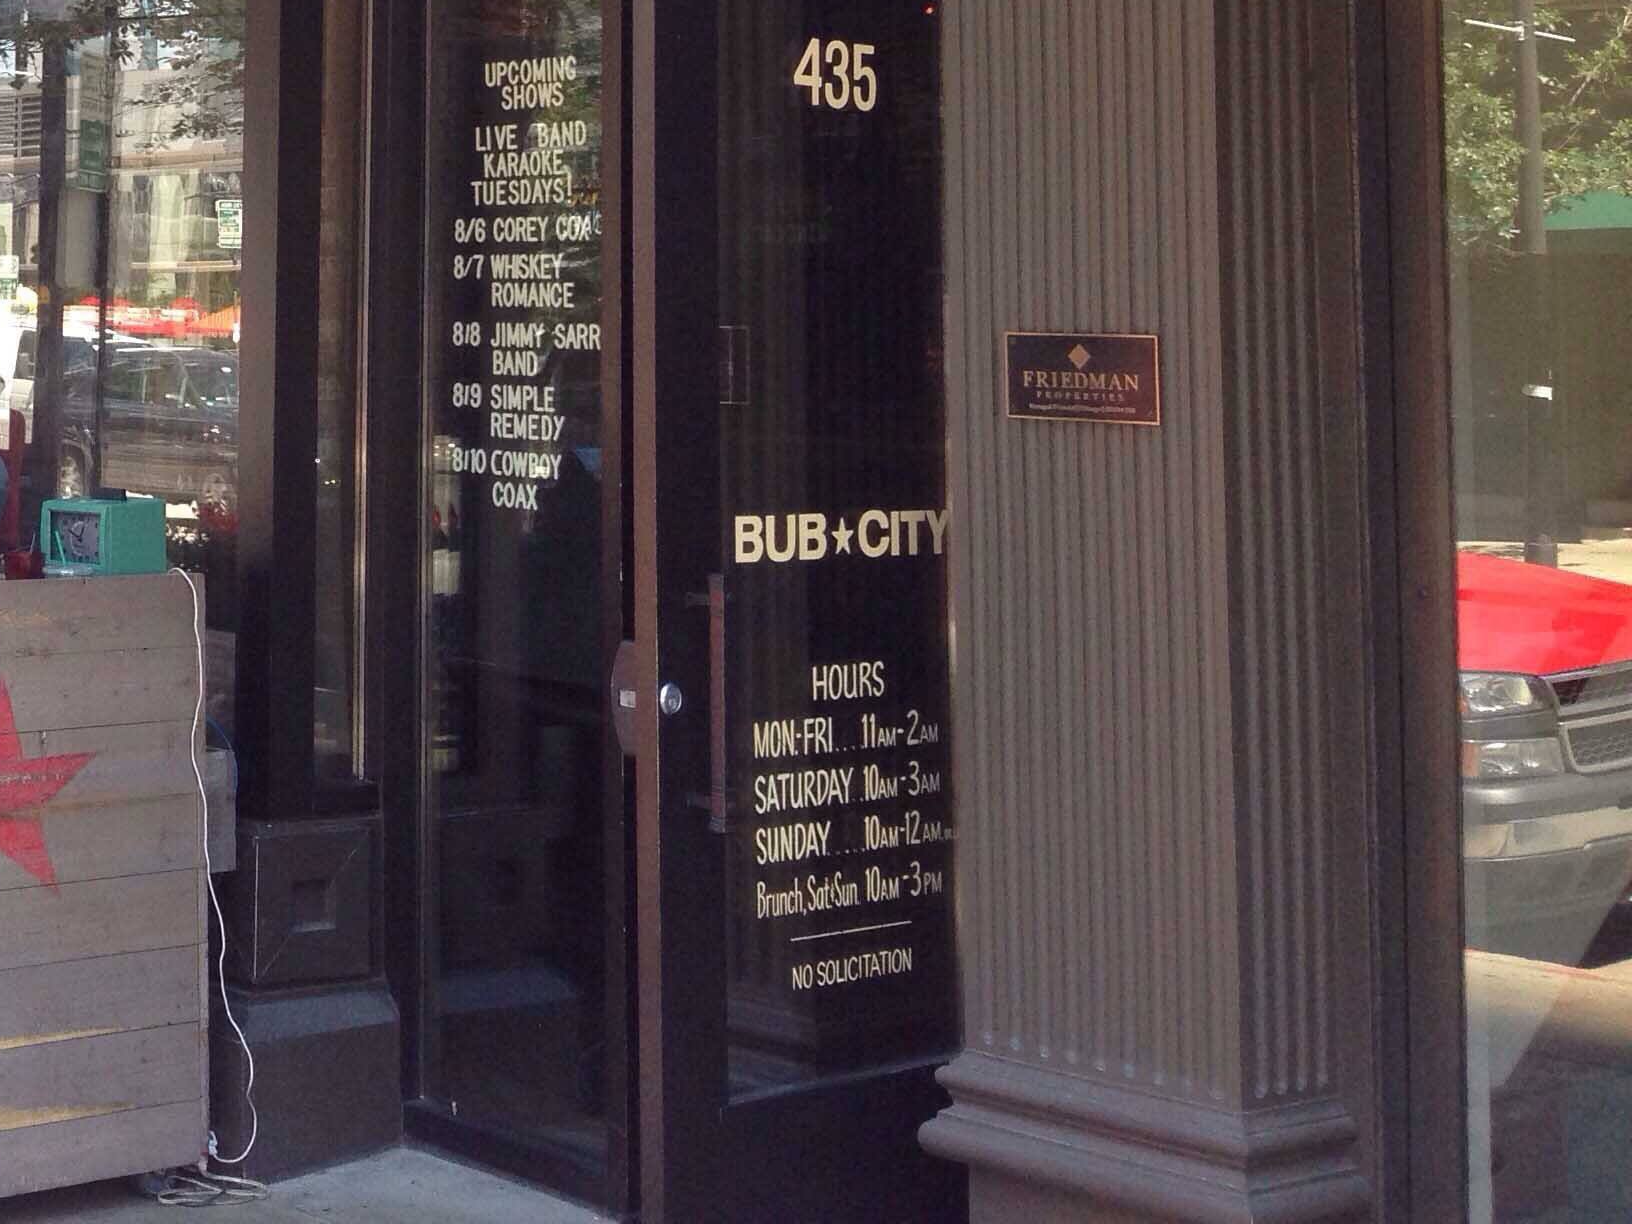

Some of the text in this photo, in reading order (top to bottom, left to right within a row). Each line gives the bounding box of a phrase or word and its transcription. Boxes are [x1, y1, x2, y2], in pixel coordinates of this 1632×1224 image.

[484, 55, 577, 87] UPCOMING
[793, 37, 877, 112] 435
[501, 82, 565, 110] SHOWS
[475, 120, 587, 151] LIVE BAND
[483, 149, 564, 178] KARAOKE
[470, 172, 573, 206] TUESDAYS!
[454, 218, 486, 243] 8/6
[493, 216, 549, 242] COREY
[453, 253, 564, 279] 8/7 WHISKEY
[491, 282, 575, 308] ROMANCE
[452, 321, 601, 350] 8/8 JIMMY SARR
[492, 350, 539, 376] BAND
[1023, 370, 1139, 391] FRIEDMAN
[452, 382, 555, 412] 8/9 SIMPLE
[1036, 391, 1125, 402] PROPERTIES
[490, 413, 565, 441] REMEDY
[452, 447, 562, 480] 8/10 COWBOY
[492, 481, 538, 510] COAX
[735, 509, 949, 563] BUB CITY
[812, 661, 885, 701] HOURS
[792, 948, 913, 991] NO SOLICITATION
